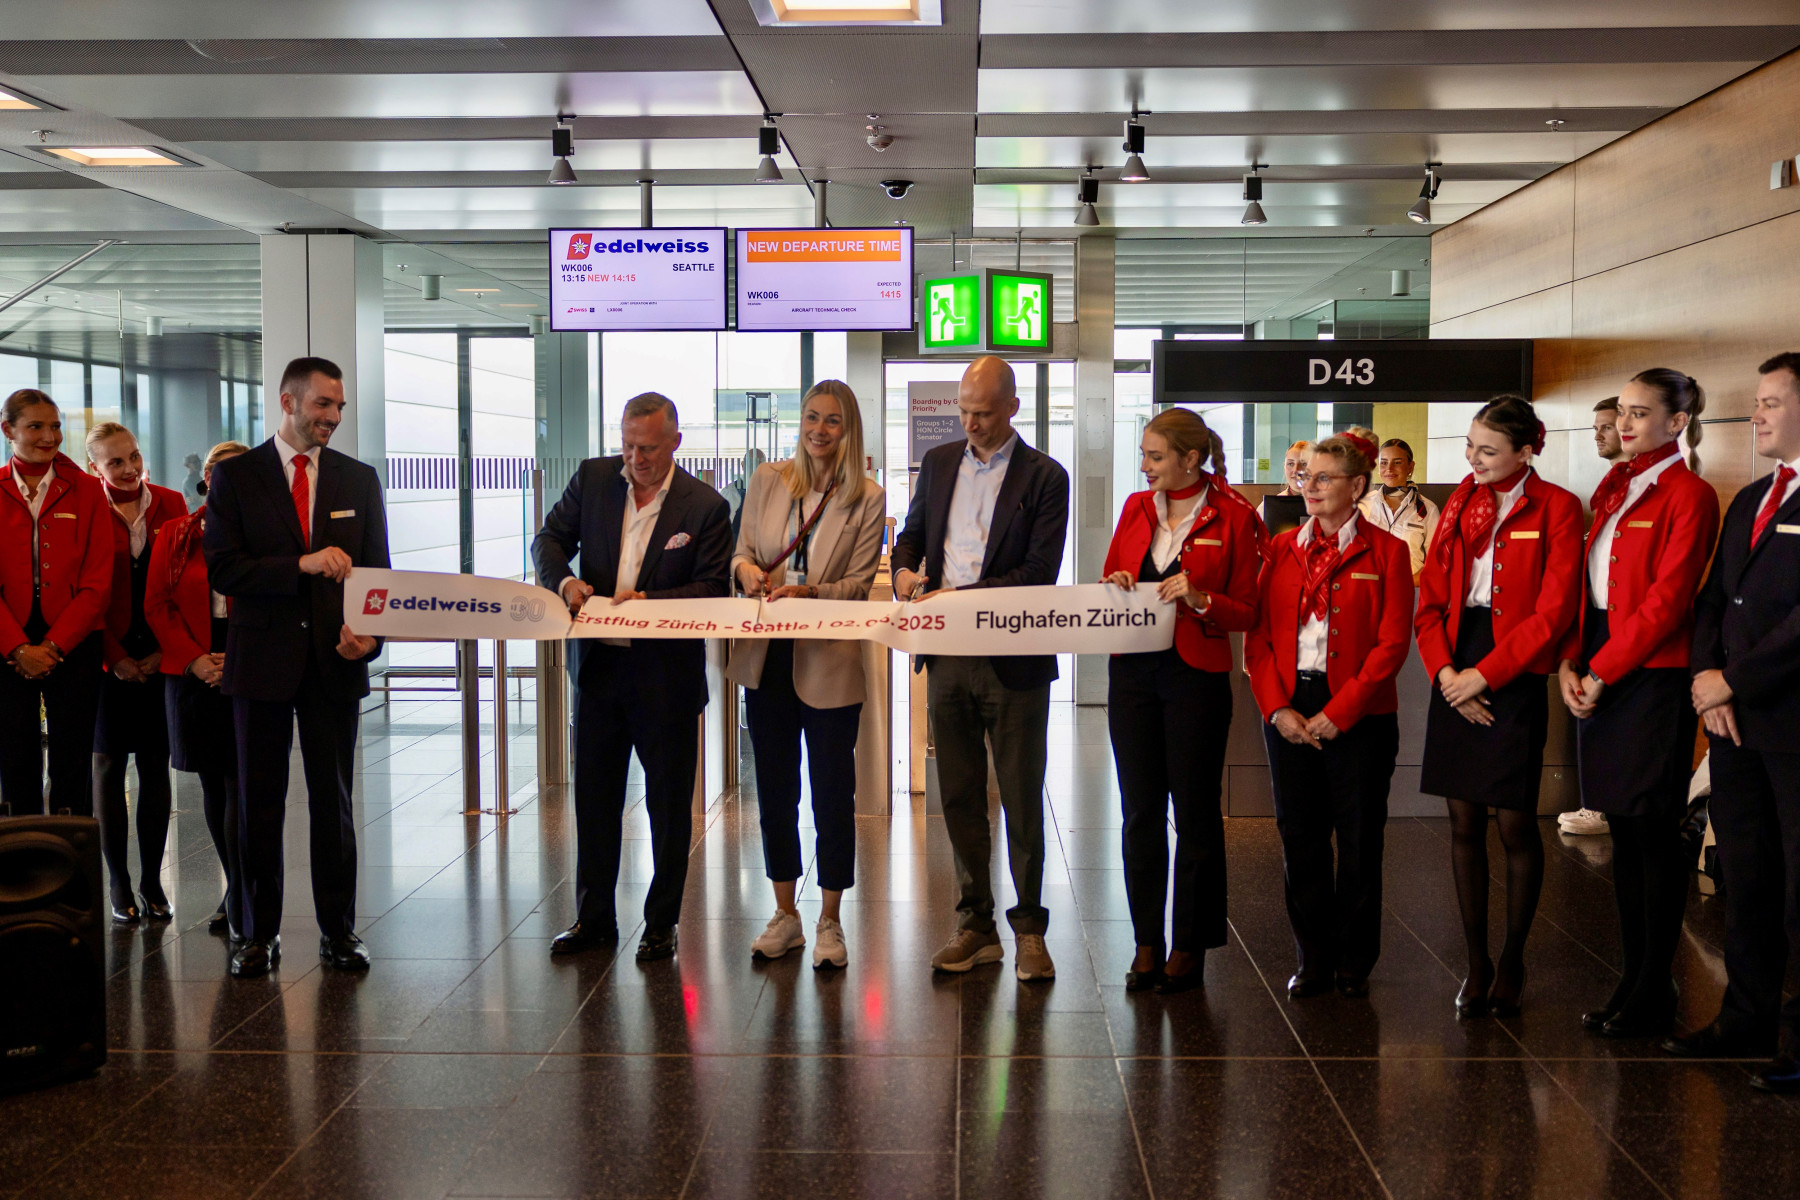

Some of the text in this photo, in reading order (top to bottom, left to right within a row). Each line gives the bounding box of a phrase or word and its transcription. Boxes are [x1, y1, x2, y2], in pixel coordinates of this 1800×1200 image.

[594, 239, 709, 253] edelweiss
[748, 240, 900, 252] NEW DEPARTURE TIME
[672, 264, 714, 272] SEATTLE
[944, 398, 951, 406] by
[916, 420, 940, 428] Groups
[390, 596, 546, 622] edelweiss 30
[576, 612, 650, 628] Erstflug
[656, 619, 716, 631] Zürich
[740, 620, 808, 633] Seattle
[976, 608, 1156, 634] Flughafen Zürich
